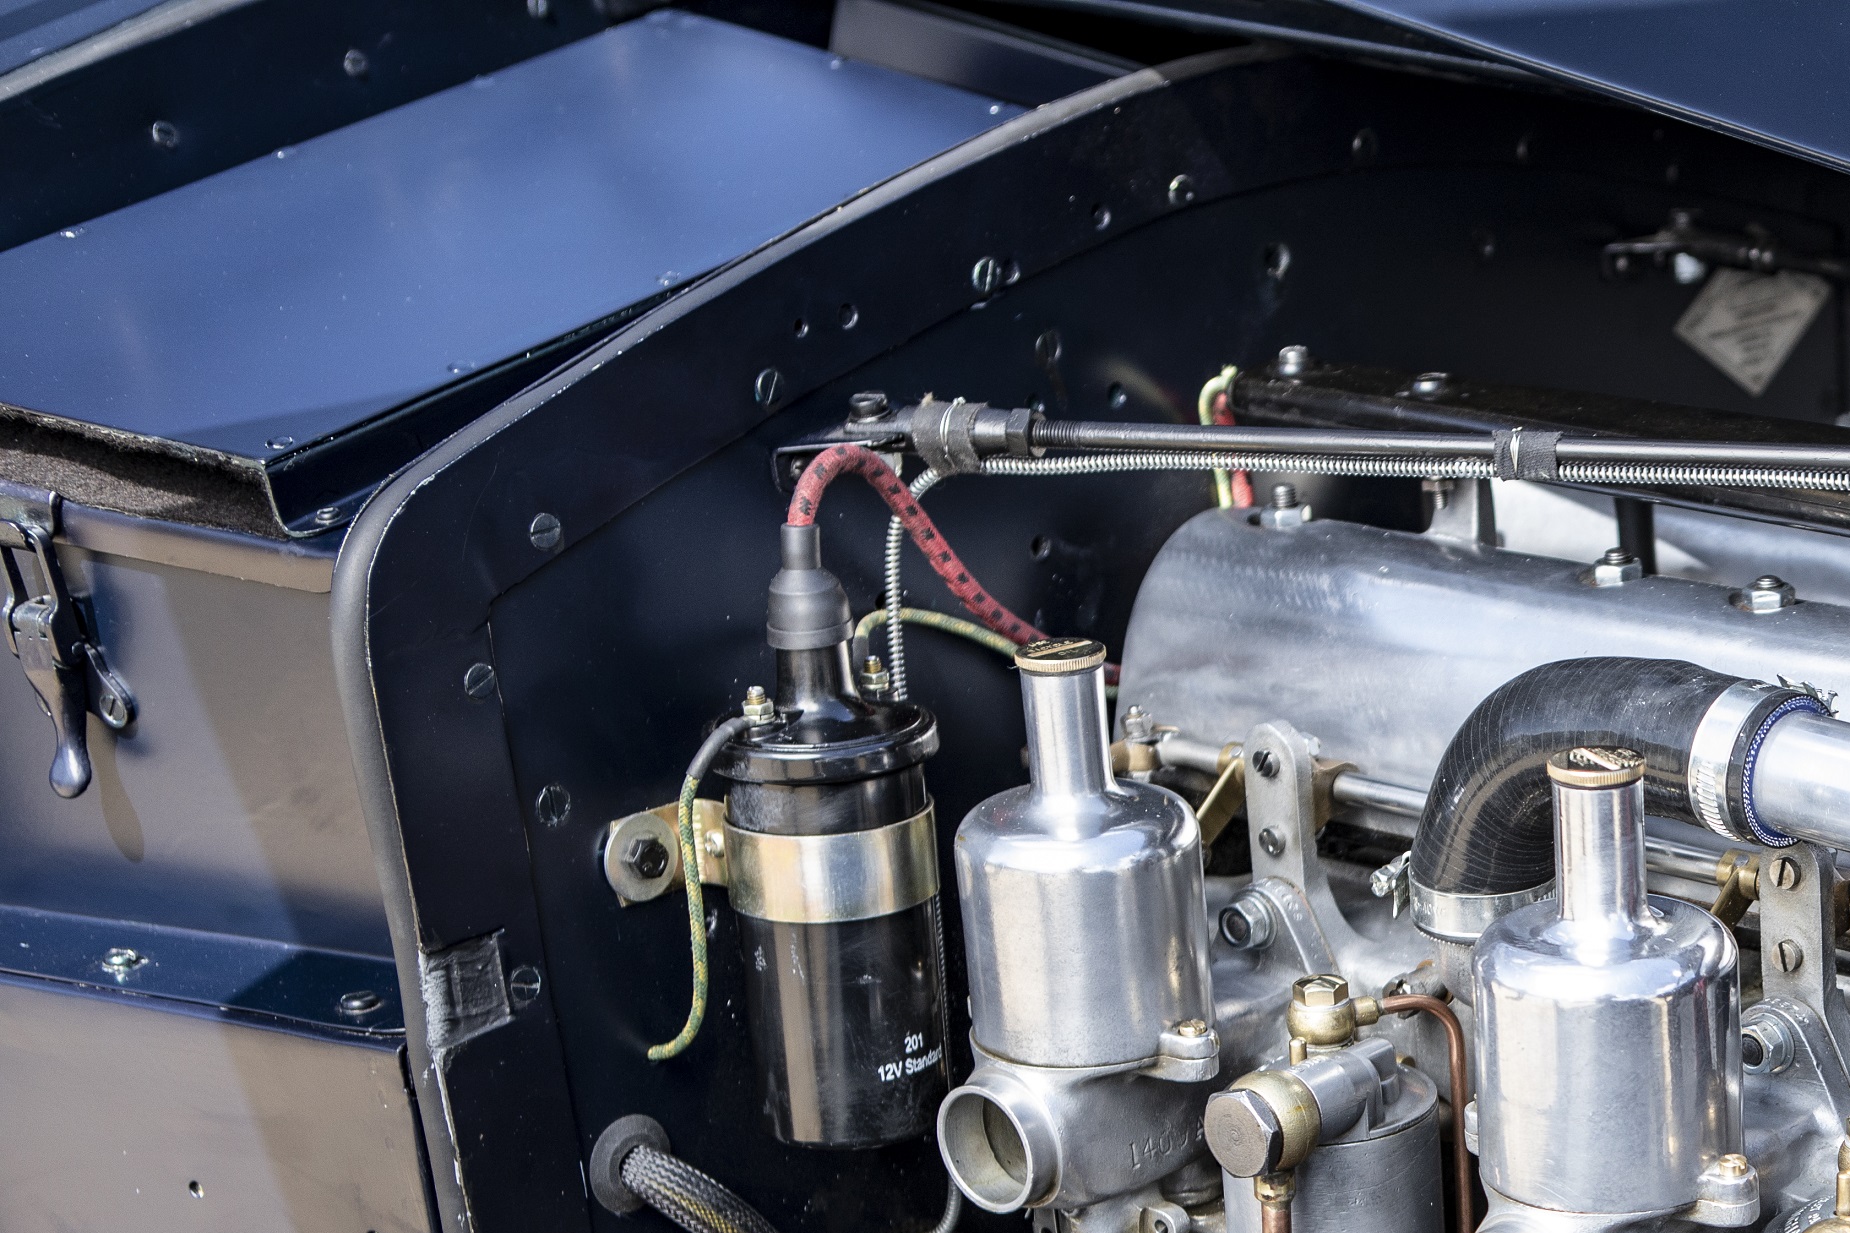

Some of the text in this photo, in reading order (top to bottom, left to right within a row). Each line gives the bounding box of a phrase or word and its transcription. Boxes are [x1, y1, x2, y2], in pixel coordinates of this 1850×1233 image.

[904, 1031, 923, 1054] 201
[877, 1042, 942, 1082] 12V Standard
